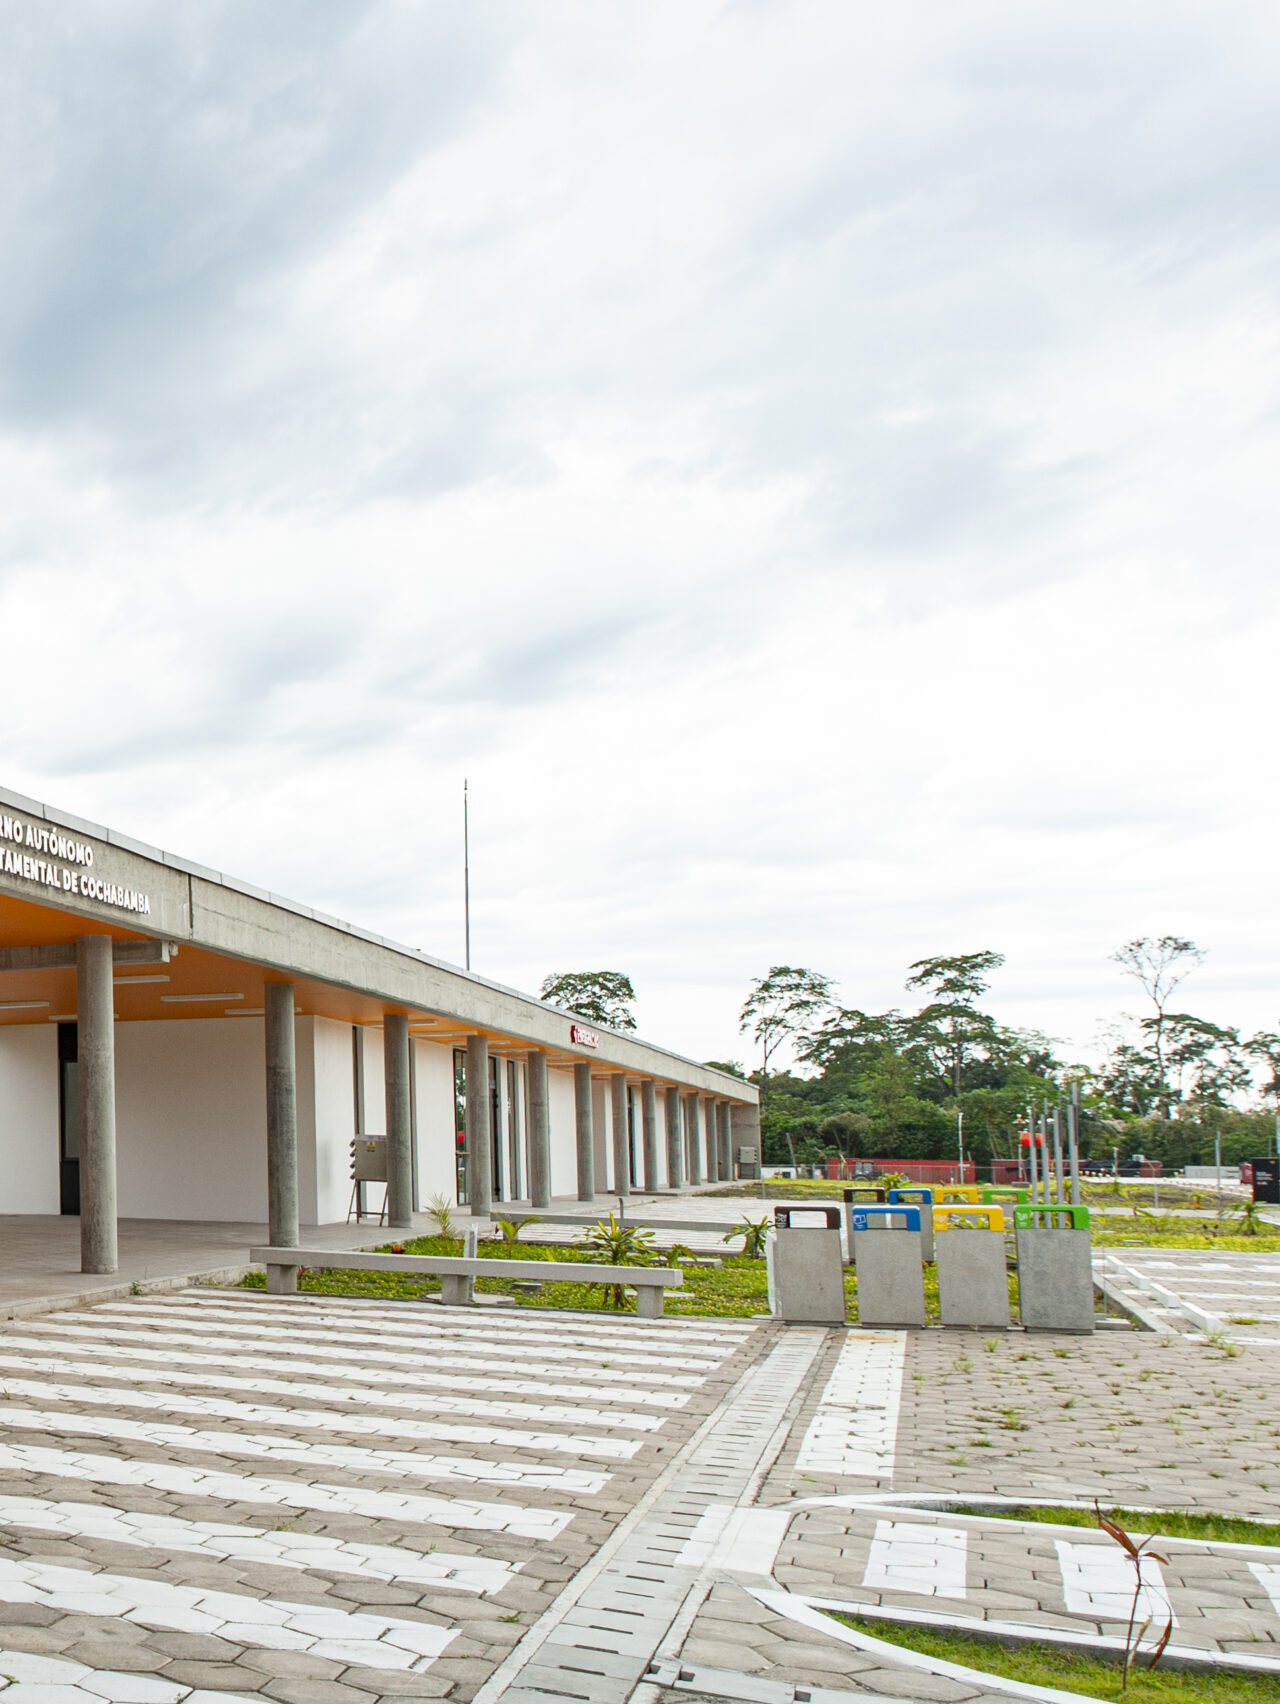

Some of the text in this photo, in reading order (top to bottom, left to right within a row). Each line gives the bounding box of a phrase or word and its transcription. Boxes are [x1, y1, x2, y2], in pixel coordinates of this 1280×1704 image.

[26, 826, 94, 867] AUTÓNOMO
[63, 868, 78, 893] DE
[81, 874, 151, 914] COCHABAMBA
